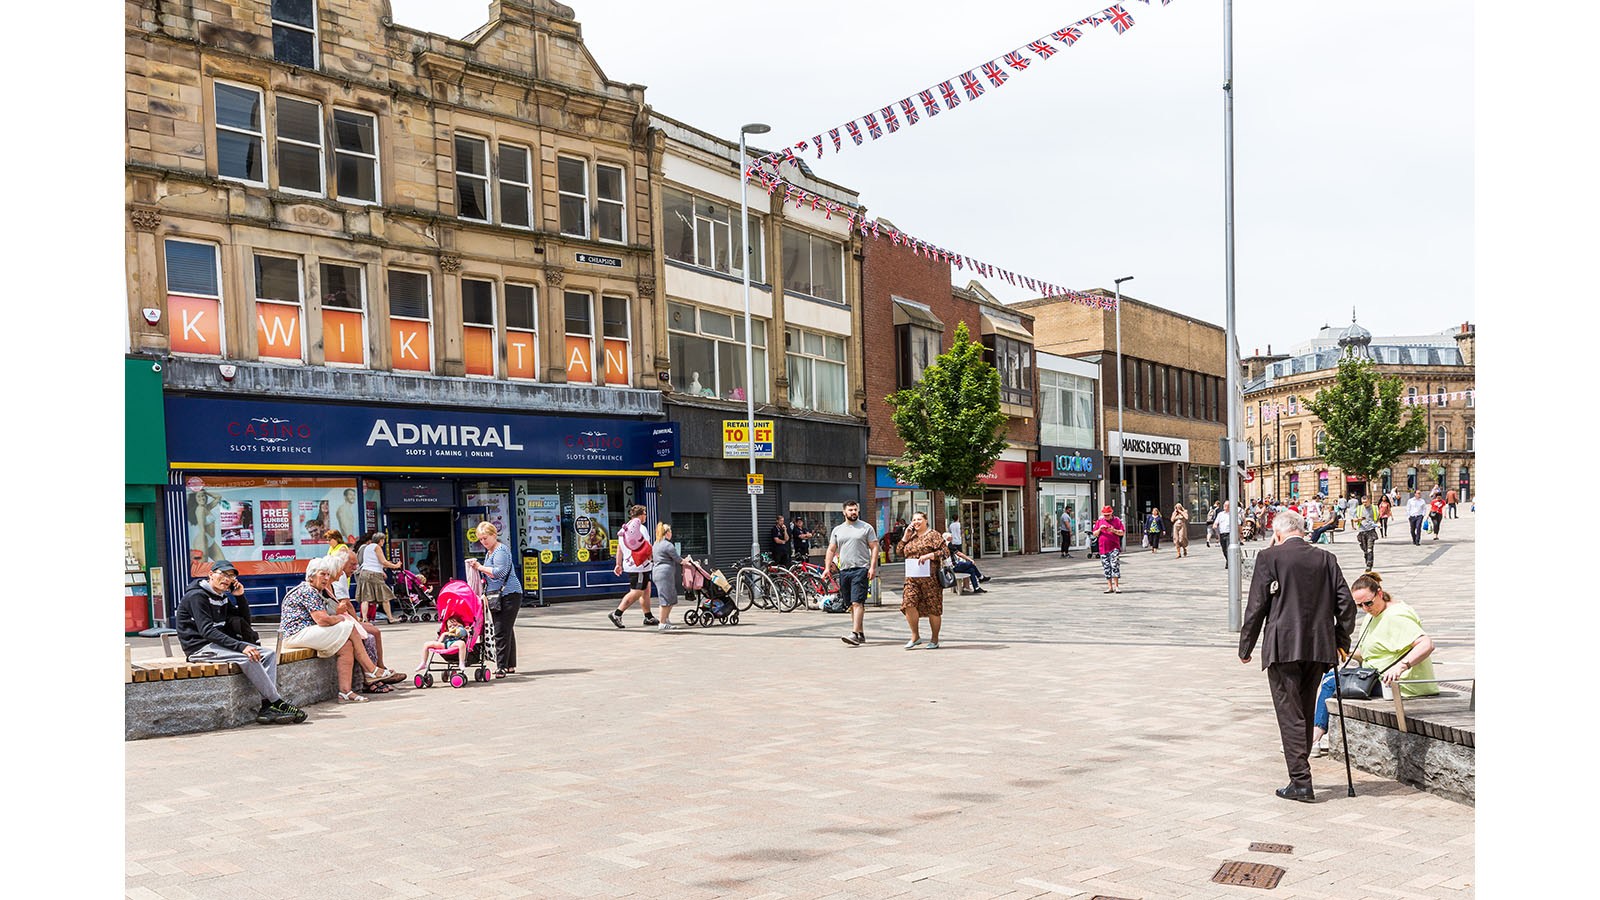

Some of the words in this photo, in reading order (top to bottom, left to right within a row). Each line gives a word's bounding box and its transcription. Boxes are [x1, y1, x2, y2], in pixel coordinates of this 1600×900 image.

[588, 257, 616, 265] CHEAPSIDE
[228, 422, 311, 438] CASINO
[366, 419, 524, 450] ADMIRAL
[725, 430, 743, 441] TO
[564, 435, 622, 449] CASINO
[230, 444, 257, 452] SLOTS
[260, 445, 312, 454] EXPERIENCE
[262, 509, 288, 517] FREE
[517, 485, 528, 552] ADMIRA
